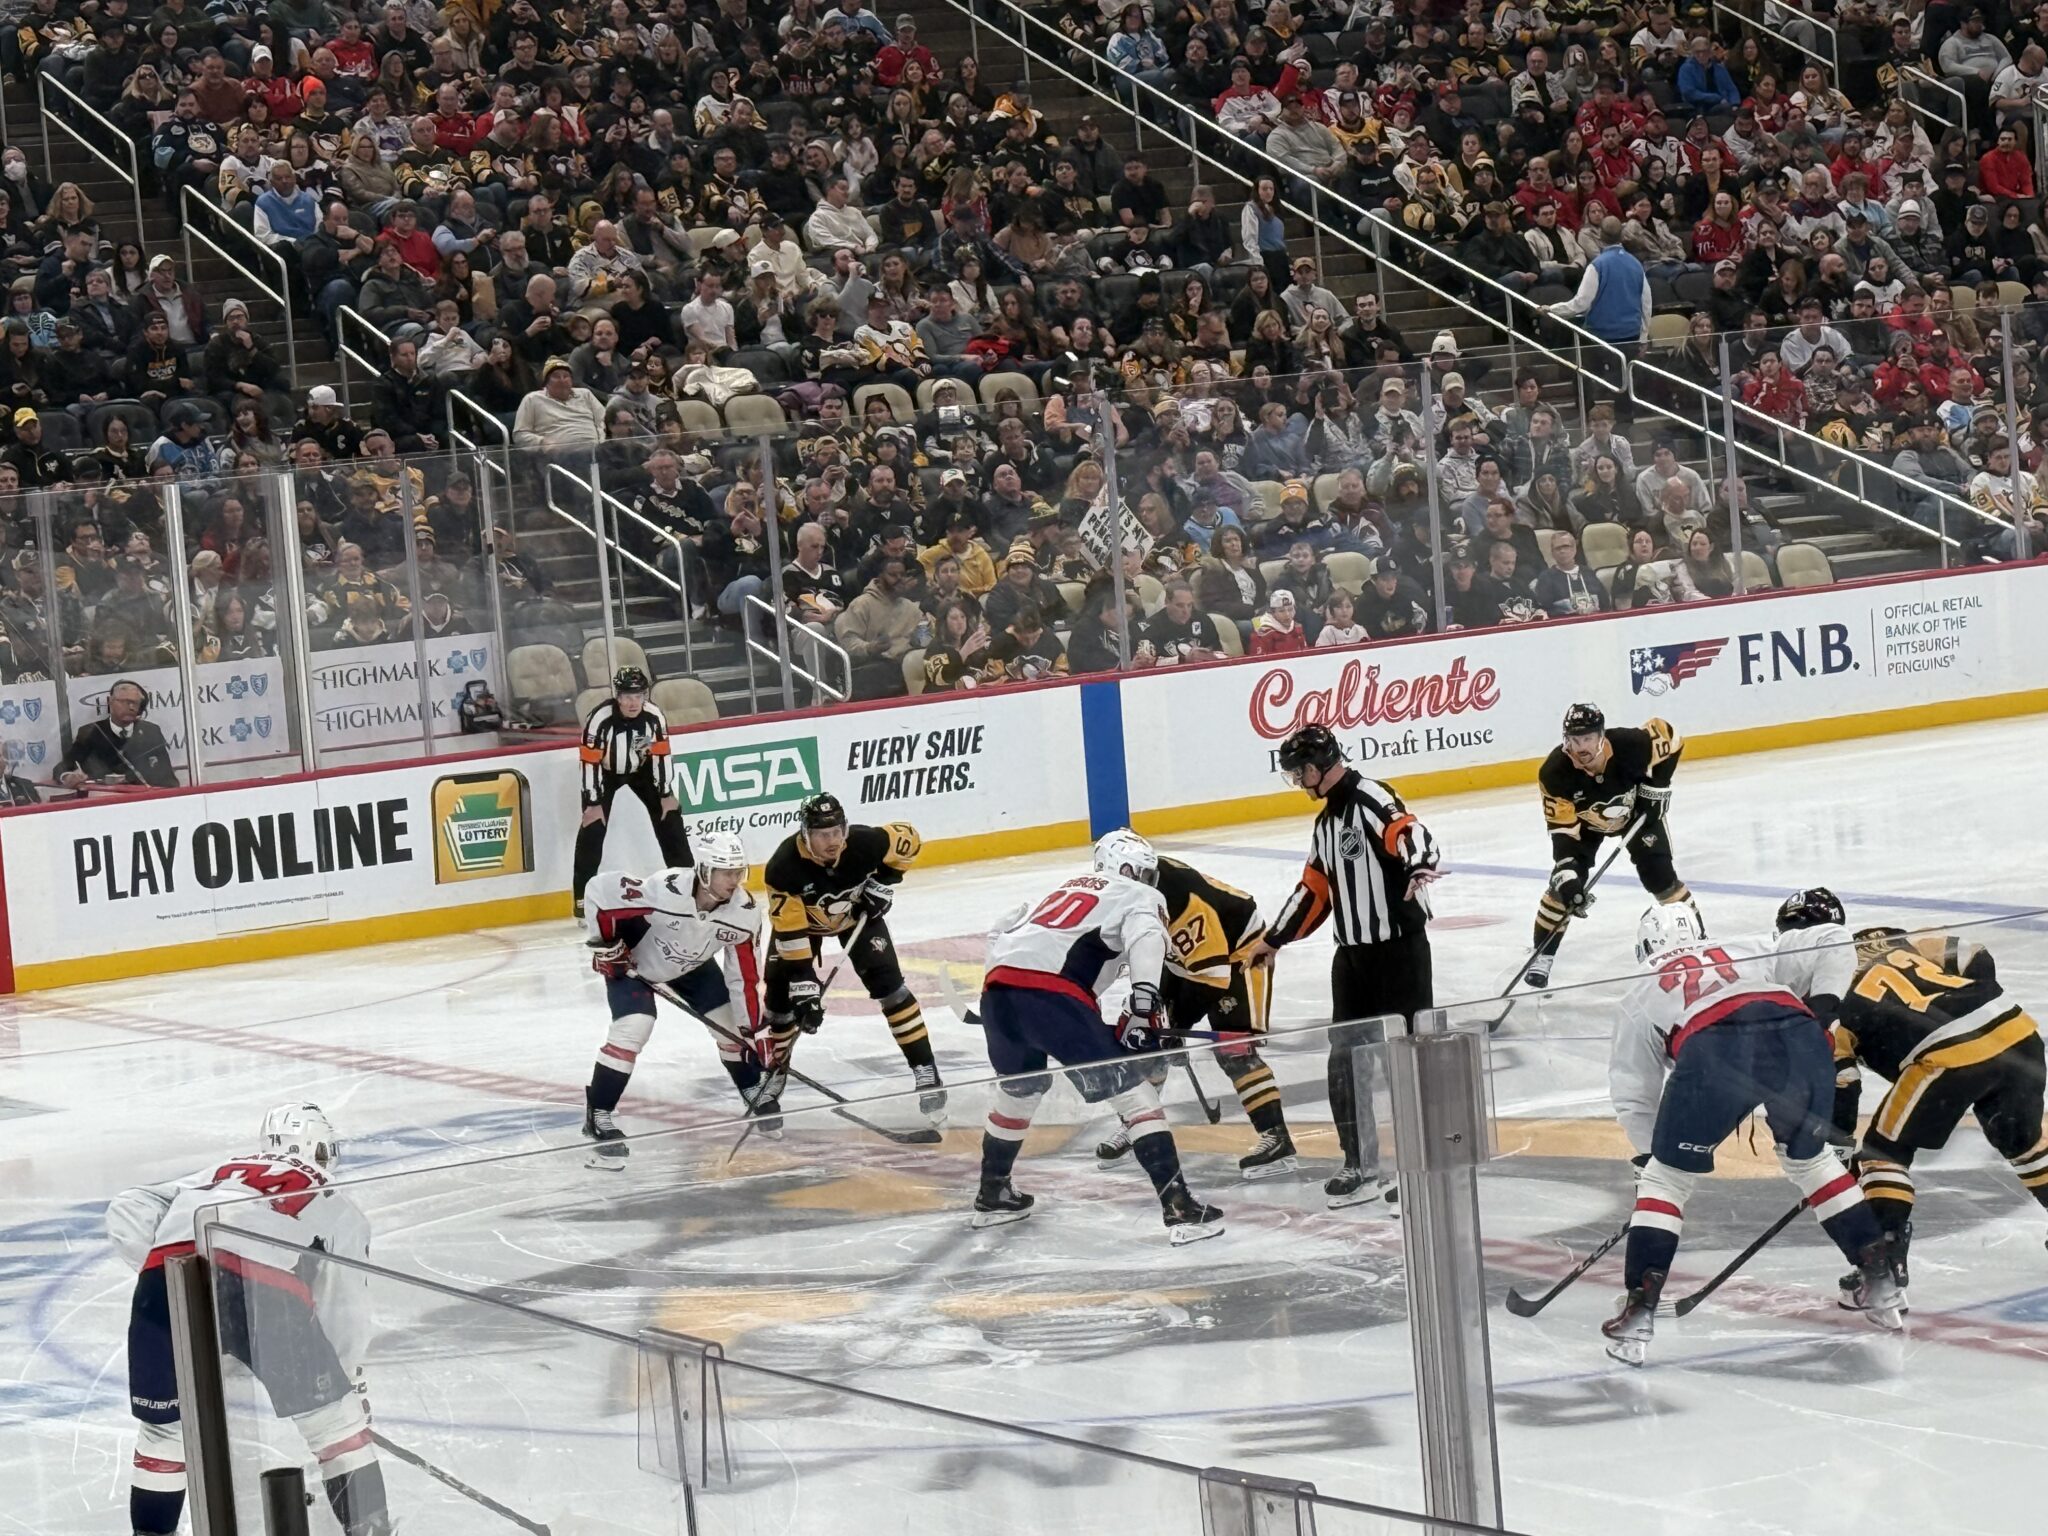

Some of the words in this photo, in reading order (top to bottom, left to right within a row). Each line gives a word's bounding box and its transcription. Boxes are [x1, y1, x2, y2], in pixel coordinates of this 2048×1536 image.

[1884, 601, 1939, 619] OFFICIAL
[1942, 596, 1983, 611] RETAIL
[1885, 621, 1921, 638] BANK
[1923, 619, 1940, 634] OF
[1942, 616, 1967, 630] THE
[1738, 623, 1860, 685] F.N.B.
[1886, 636, 1960, 657] PITTSBURGH
[1249, 656, 1500, 739] Caliente
[847, 733, 921, 770] EVERY
[925, 725, 984, 760] SAVE
[1361, 729, 1420, 761] Draft
[1425, 727, 1494, 750] House
[671, 747, 813, 806] MSA
[860, 762, 975, 804] MATTERS.
[458, 828, 508, 842] LOTTERY
[696, 816, 744, 835] Safety
[749, 810, 801, 828] Compa
[73, 826, 179, 904] PLAY
[192, 798, 413, 889] ONLINE
[1171, 914, 1206, 957] 87
[1658, 946, 1740, 1011] 21
[1854, 949, 1975, 1013] 72
